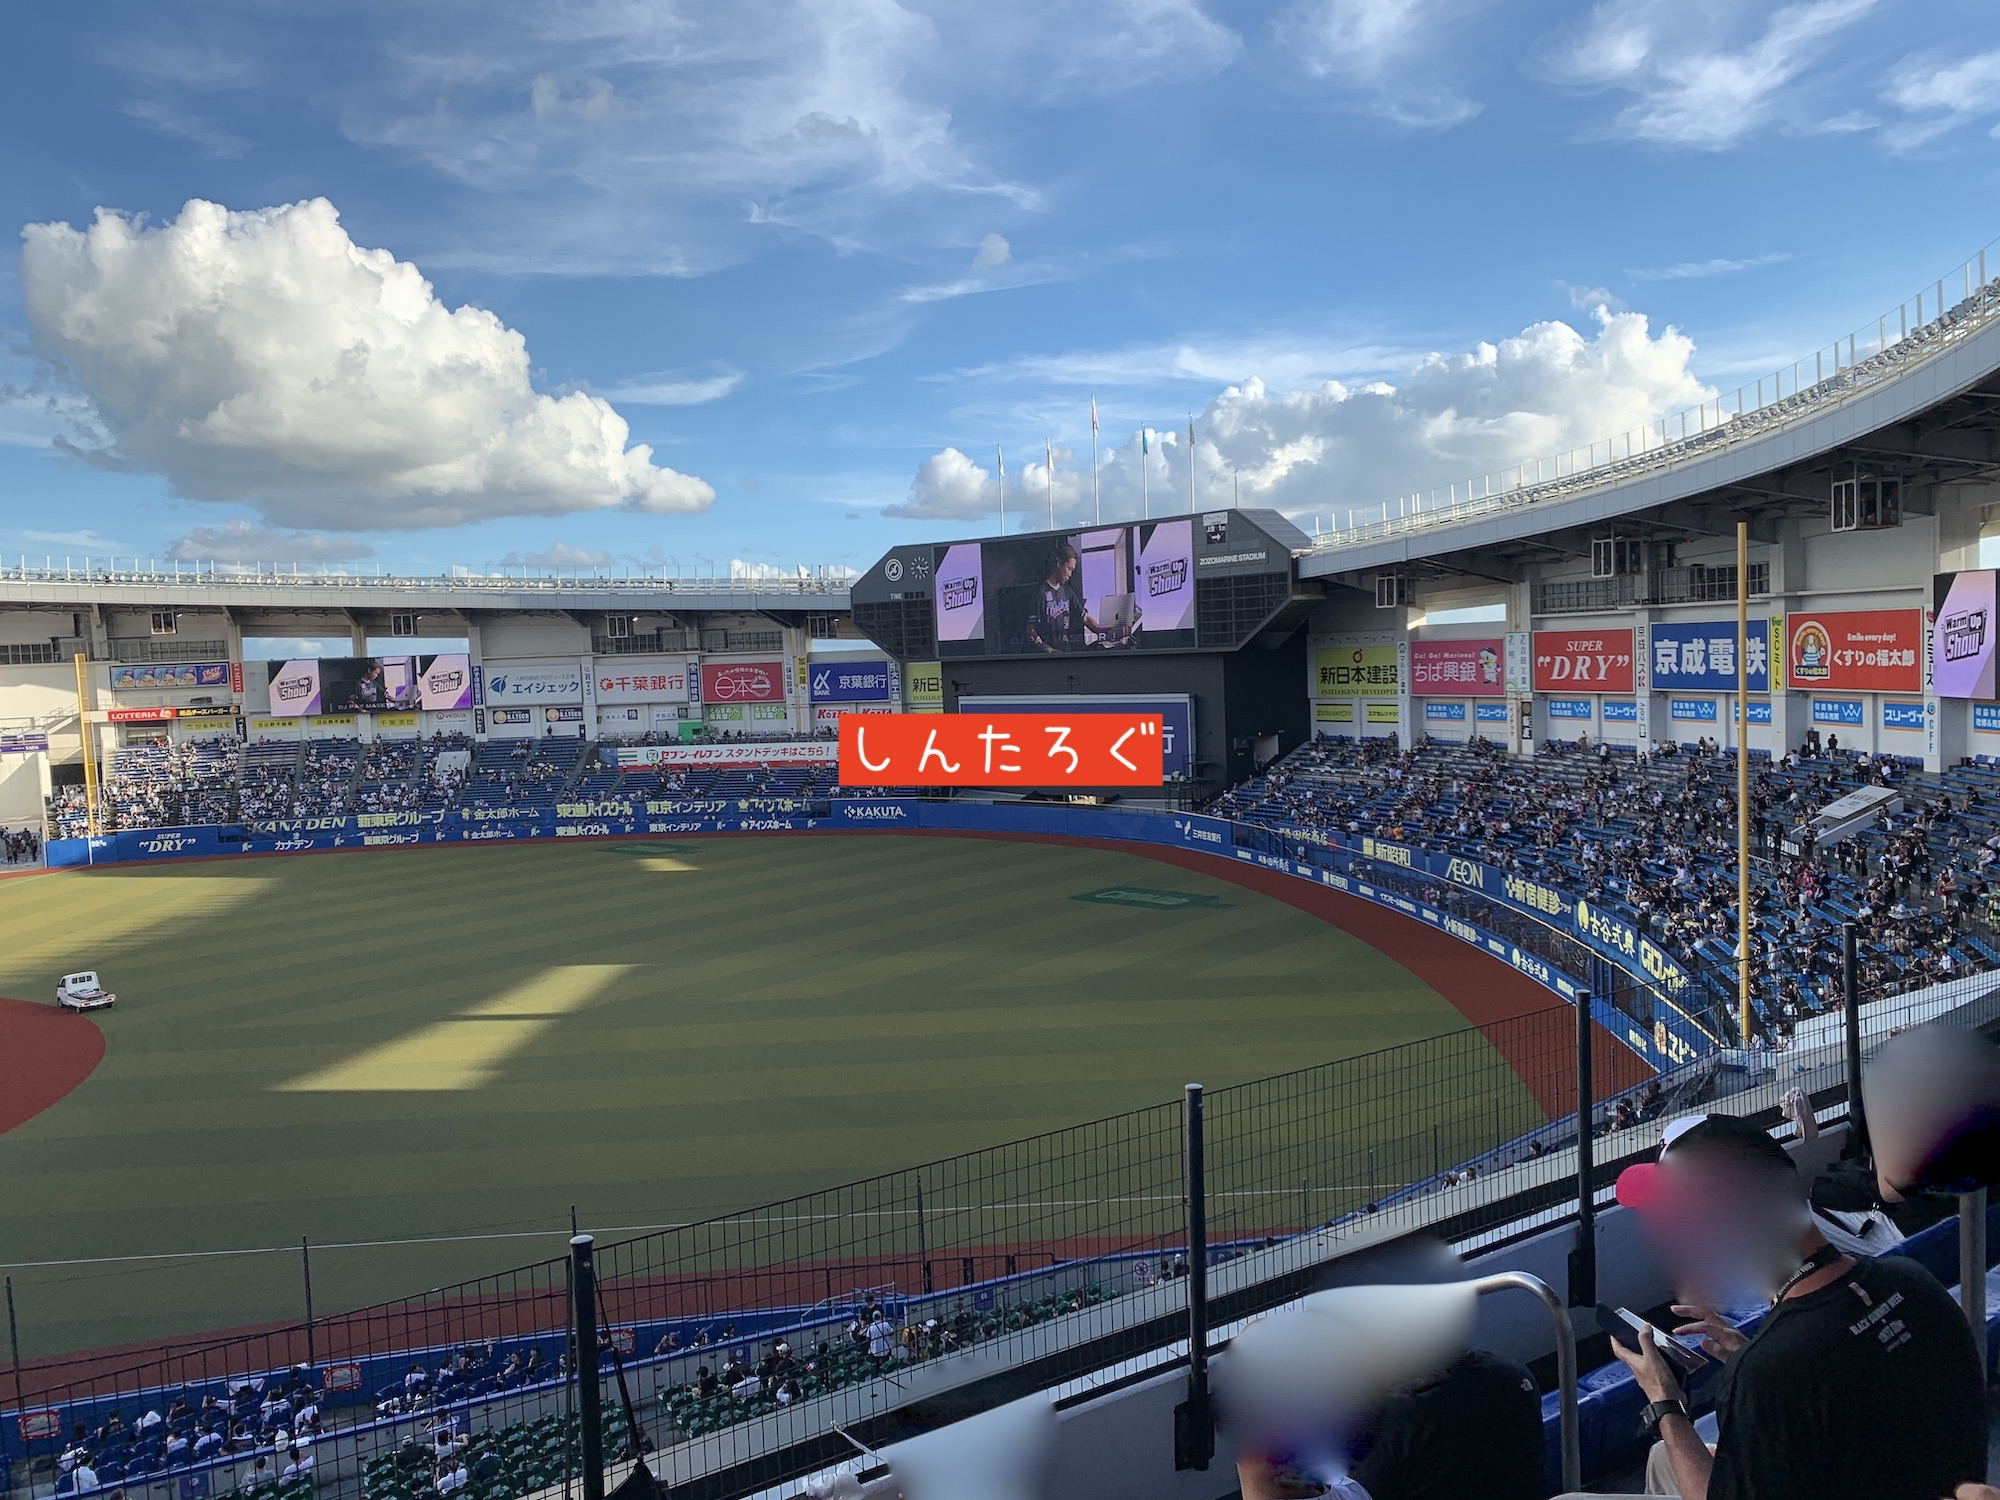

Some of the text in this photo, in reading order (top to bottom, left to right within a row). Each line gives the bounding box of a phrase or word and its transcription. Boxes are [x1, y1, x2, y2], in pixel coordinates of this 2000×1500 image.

[1151, 574, 1182, 596] Show
[946, 590, 973, 609] Show
[1946, 614, 1967, 630] Warm
[1566, 640, 1603, 652] SUPER
[1946, 632, 1980, 661] Show
[1654, 637, 1767, 675] 京成電鉄
[1833, 649, 1915, 667] くすりの福太郎
[1320, 665, 1398, 685] 新日本建設
[1414, 661, 1477, 682] ちば興銀
[432, 679, 460, 695] Show
[512, 681, 580, 694] エイジェック
[615, 674, 684, 691] 千葉銀行
[838, 675, 888, 689] 京葉銀行
[913, 676, 943, 692] 新日
[281, 686, 309, 701] Show
[111, 711, 157, 720] LOTTERIA
[473, 807, 539, 821] 金太郎ホーム
[556, 801, 633, 819] 東進ハイスクール
[646, 800, 727, 814] 東京インテリア
[857, 806, 904, 816] KAKUTA
[358, 809, 445, 828] 新東京グループ
[471, 829, 515, 839] 金太郎ホーム
[556, 825, 609, 837] 東進ハイスクール
[649, 822, 701, 833] 東京インテリア
[156, 832, 182, 840] SUPER
[364, 833, 420, 846] 新東京グループ
[275, 839, 314, 851] カナデン
[1376, 842, 1411, 867] 新昭和
[1590, 910, 1636, 959] 古谷式典
[1849, 1318, 1871, 1336] BLACK
[1887, 1292, 1905, 1311] WEEK
